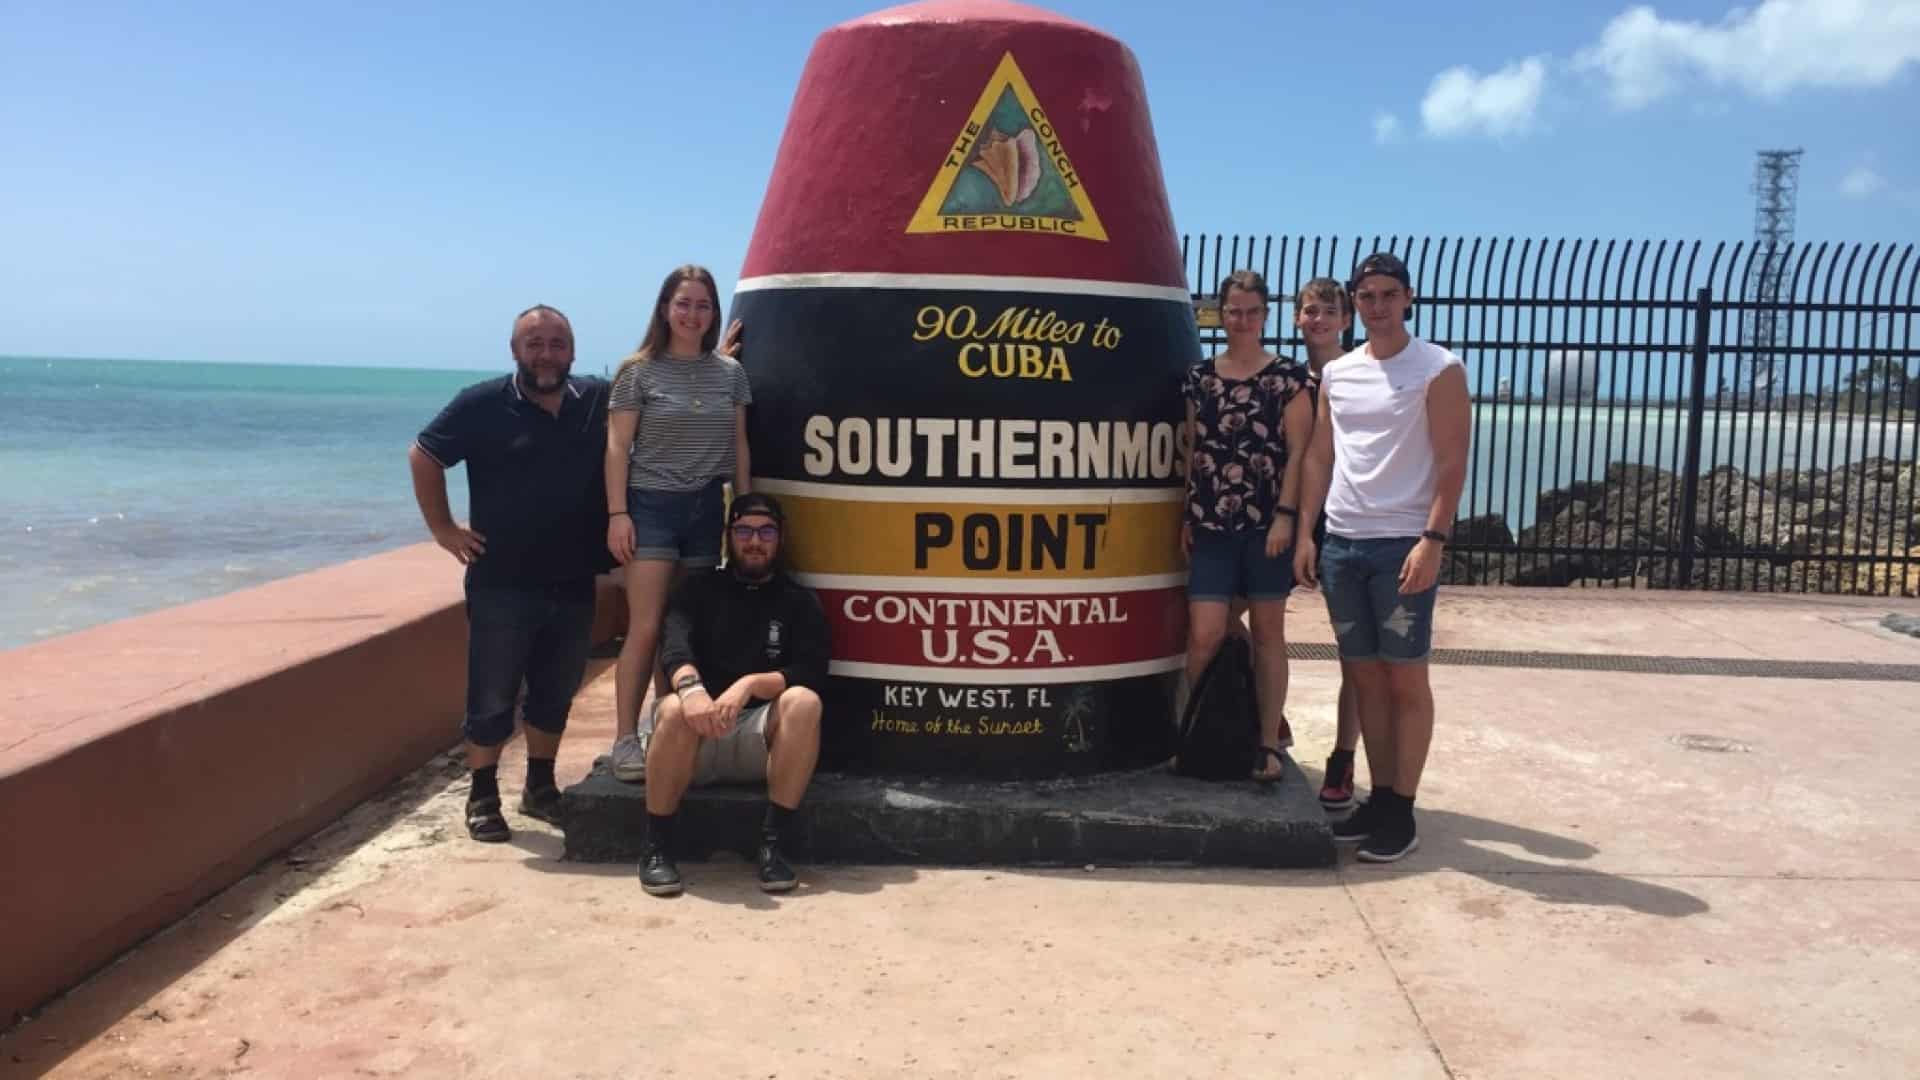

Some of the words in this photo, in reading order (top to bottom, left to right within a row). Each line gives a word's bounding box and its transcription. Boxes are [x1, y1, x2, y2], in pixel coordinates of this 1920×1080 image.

[944, 121, 981, 167] THE
[1030, 108, 1079, 188] CONCH
[943, 216, 1076, 233] REPUBLIC
[912, 305, 976, 341] 90
[973, 306, 1085, 344] Miles
[1092, 317, 1122, 349] to
[958, 342, 1072, 381] CUBA
[914, 512, 1106, 571] POINT
[843, 595, 1127, 626] CONTINENTAL
[921, 629, 1074, 664] U.S.A.
[884, 685, 928, 707] KEY
[1027, 687, 1051, 708] FL
[871, 709, 920, 732] Home
[925, 716, 942, 733] of
[947, 718, 972, 734] the
[979, 715, 1044, 735] Sunset
